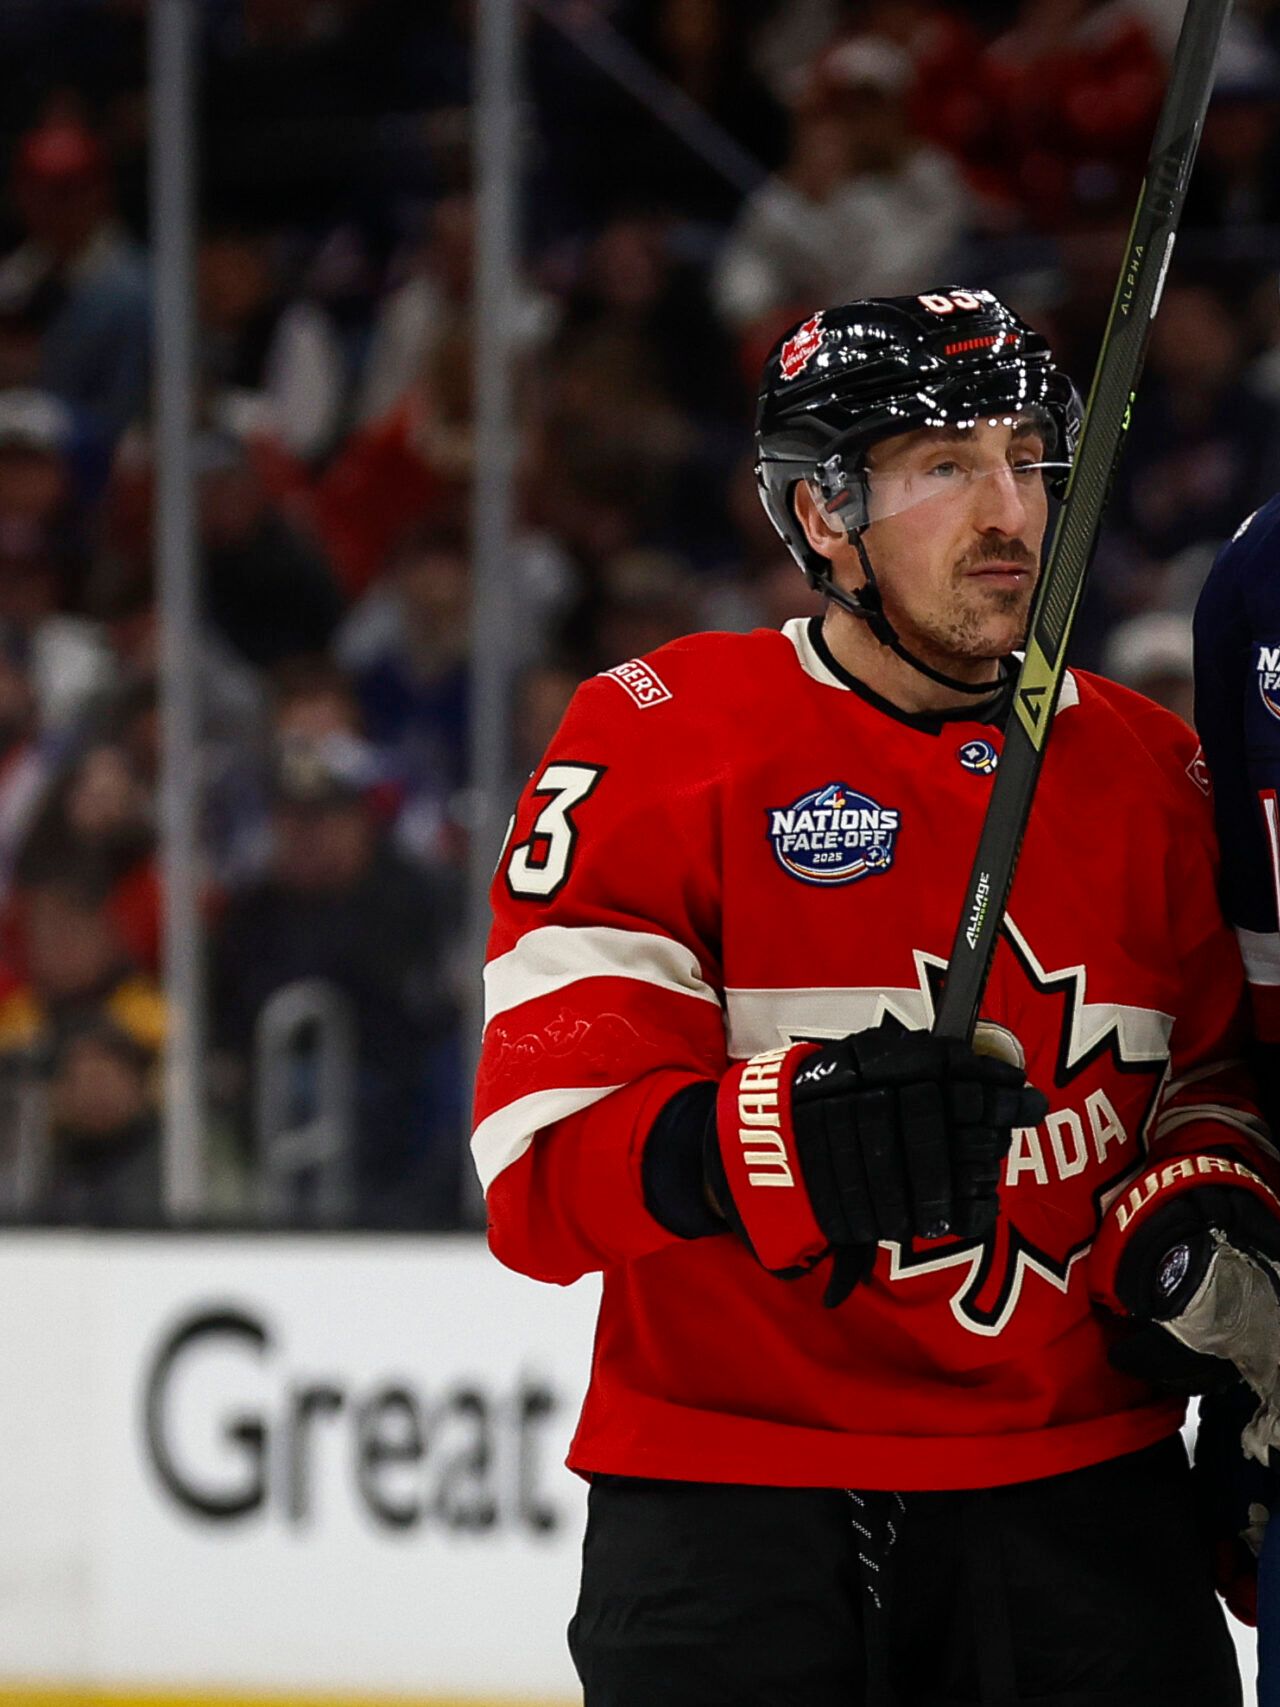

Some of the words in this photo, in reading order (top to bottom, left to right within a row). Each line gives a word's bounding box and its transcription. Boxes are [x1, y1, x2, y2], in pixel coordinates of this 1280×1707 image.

[1120, 245, 1144, 315] ALPHA
[608, 662, 662, 701] GERS
[495, 760, 608, 903] 3
[771, 809, 898, 835] NATIONS
[812, 852, 843, 863] 2025
[1005, 1088, 1128, 1186] ADA
[138, 1303, 560, 1533] Great
